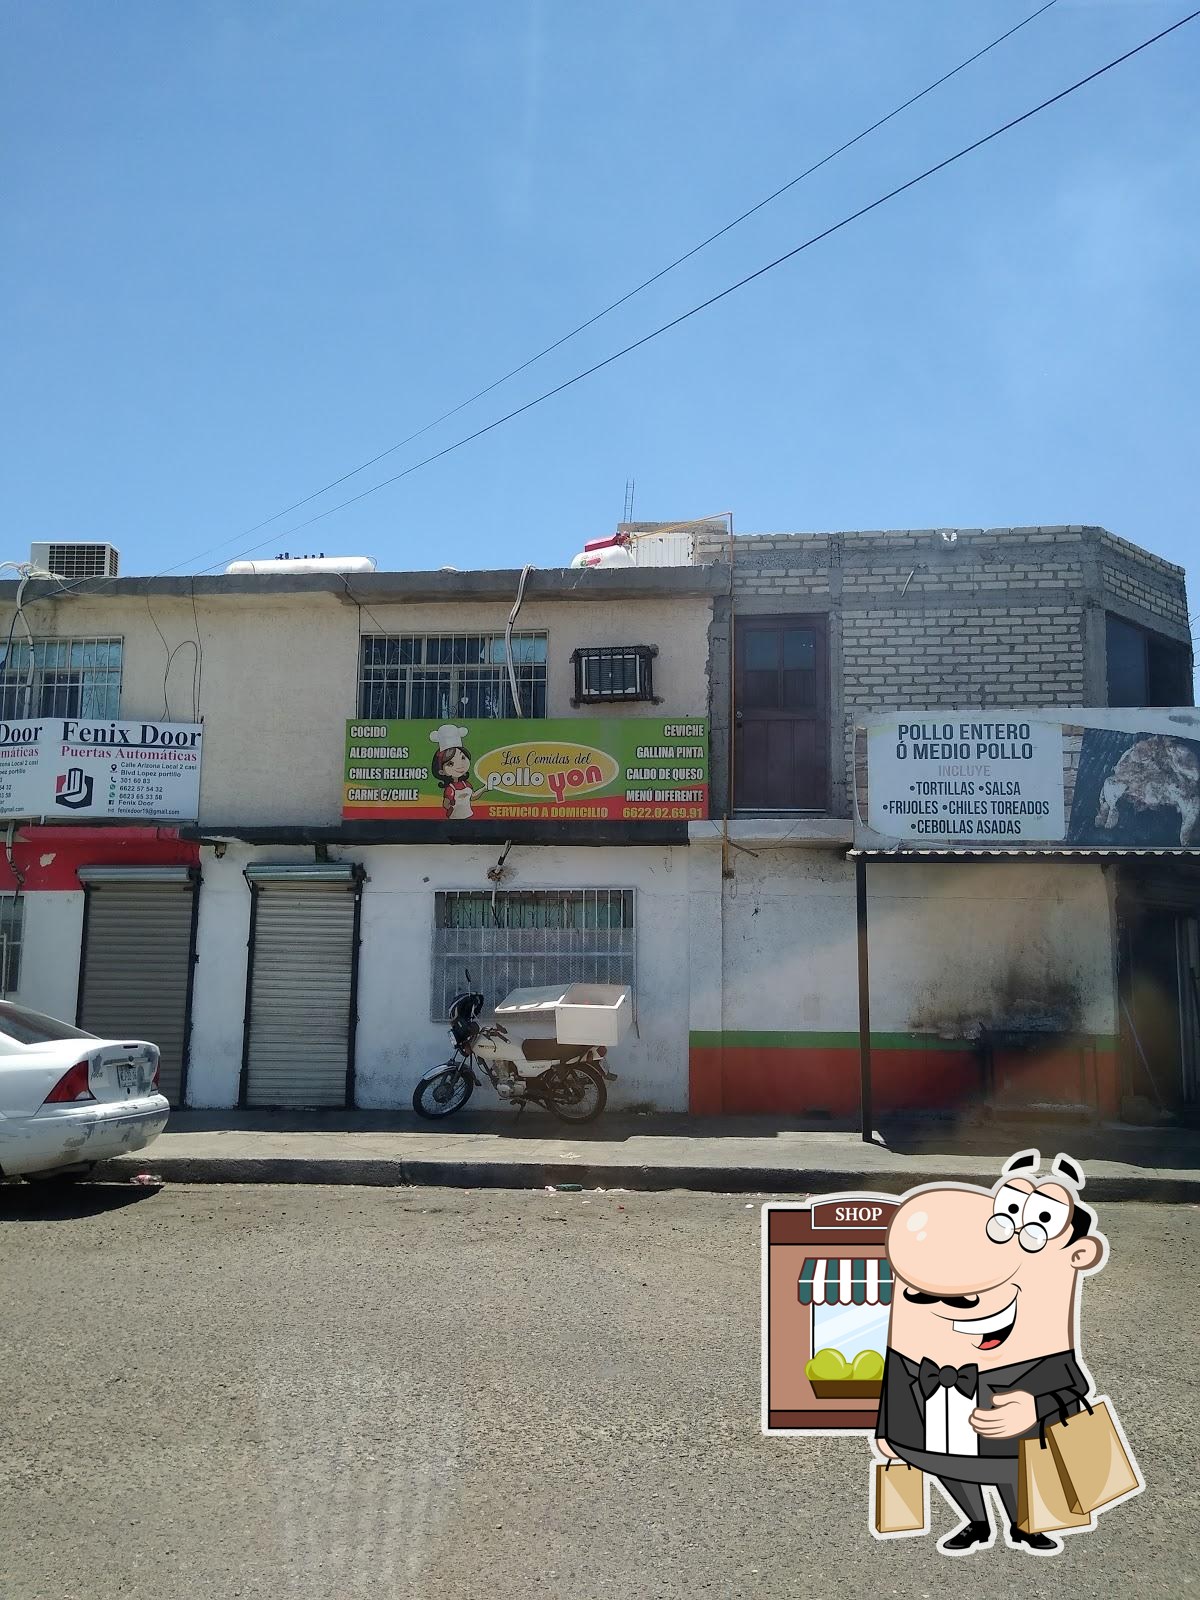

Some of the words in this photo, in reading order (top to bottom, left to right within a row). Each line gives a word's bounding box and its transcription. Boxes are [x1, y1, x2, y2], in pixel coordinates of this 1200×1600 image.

[62, 721, 132, 744] Fenix
[140, 724, 202, 747] Door
[350, 726, 387, 738] COCIDO
[664, 724, 704, 737] CEVICHE
[898, 724, 954, 740] POLLO
[959, 723, 1030, 740] ENTERO
[61, 745, 112, 758] Puertas
[115, 749, 197, 762] Automáticas
[349, 747, 409, 759] ALBONDIGAS
[636, 747, 674, 759] GALLINA
[676, 747, 704, 758] PINTA
[896, 741, 907, 759] Ó
[913, 743, 970, 759] MEDIO
[976, 743, 1033, 759] POLLO
[501, 751, 520, 766] Las
[526, 751, 570, 765] Comidas
[574, 753, 593, 765] del
[349, 768, 382, 780] CHILES
[383, 768, 428, 780] RELLENOS
[626, 768, 656, 780] CALDO
[658, 768, 670, 780] DE
[672, 768, 703, 780] QUESO
[938, 765, 991, 777] INCLUYE
[487, 768, 544, 791] pollo
[547, 765, 603, 804] yon
[348, 789, 378, 801] CARNE
[380, 789, 419, 801] C/CHILE
[626, 789, 652, 802] MENÚ
[654, 790, 704, 802] DIFERENTE
[489, 807, 539, 818] SERVICIO
[541, 807, 549, 817] A
[551, 806, 608, 818] DOMICILIO
[623, 807, 703, 818] 6622.02.69.91
[990, 800, 1050, 815] TOREADOS
[977, 819, 1021, 834] ASADAS
